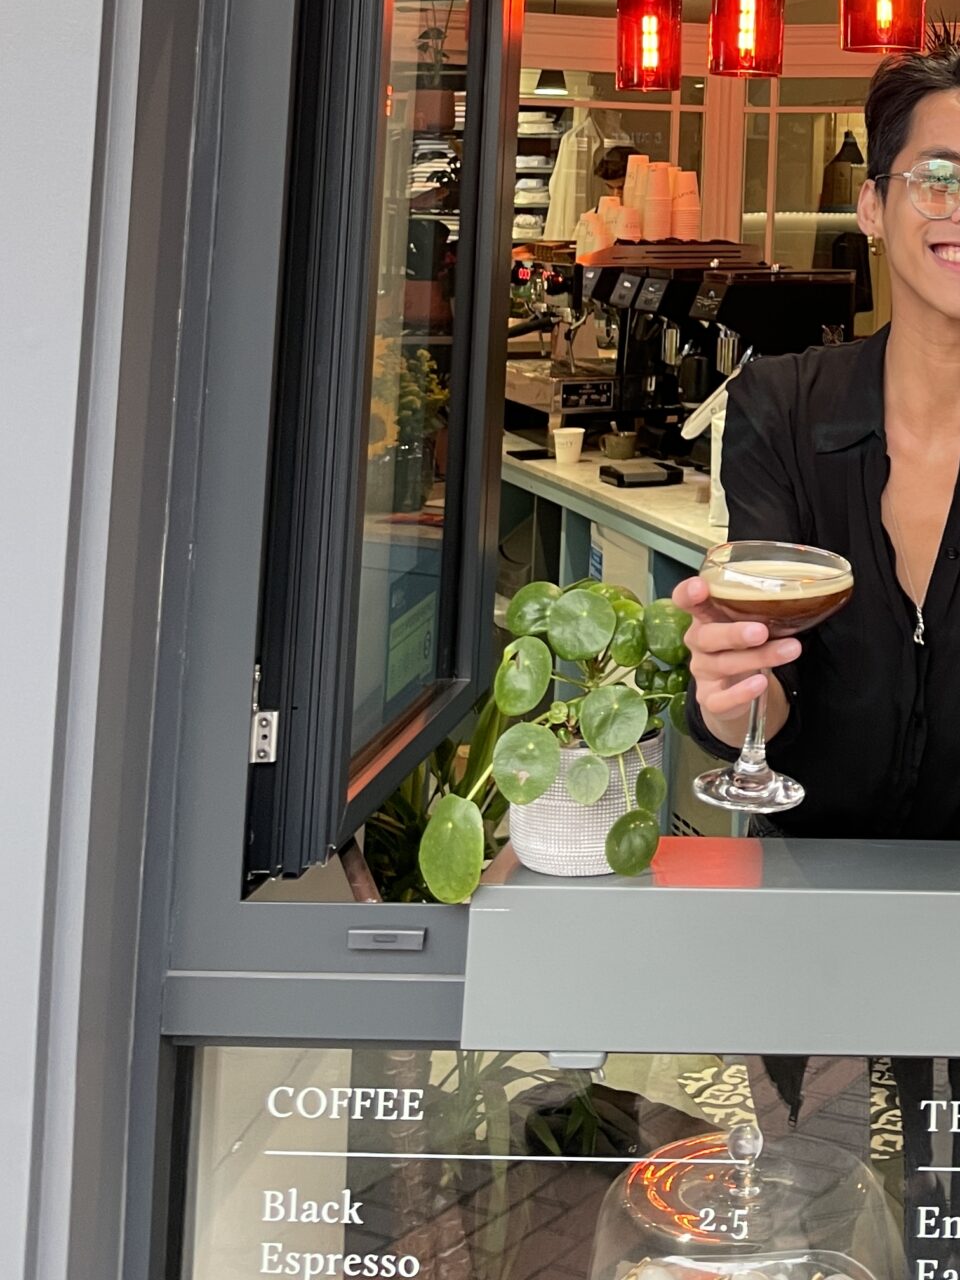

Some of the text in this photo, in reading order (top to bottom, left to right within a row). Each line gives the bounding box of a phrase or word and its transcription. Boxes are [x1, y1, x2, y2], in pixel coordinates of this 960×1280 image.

[267, 1086, 424, 1120] COFFEE
[262, 1187, 749, 1240] Black 2.5
[260, 1242, 420, 1280] Espresso
